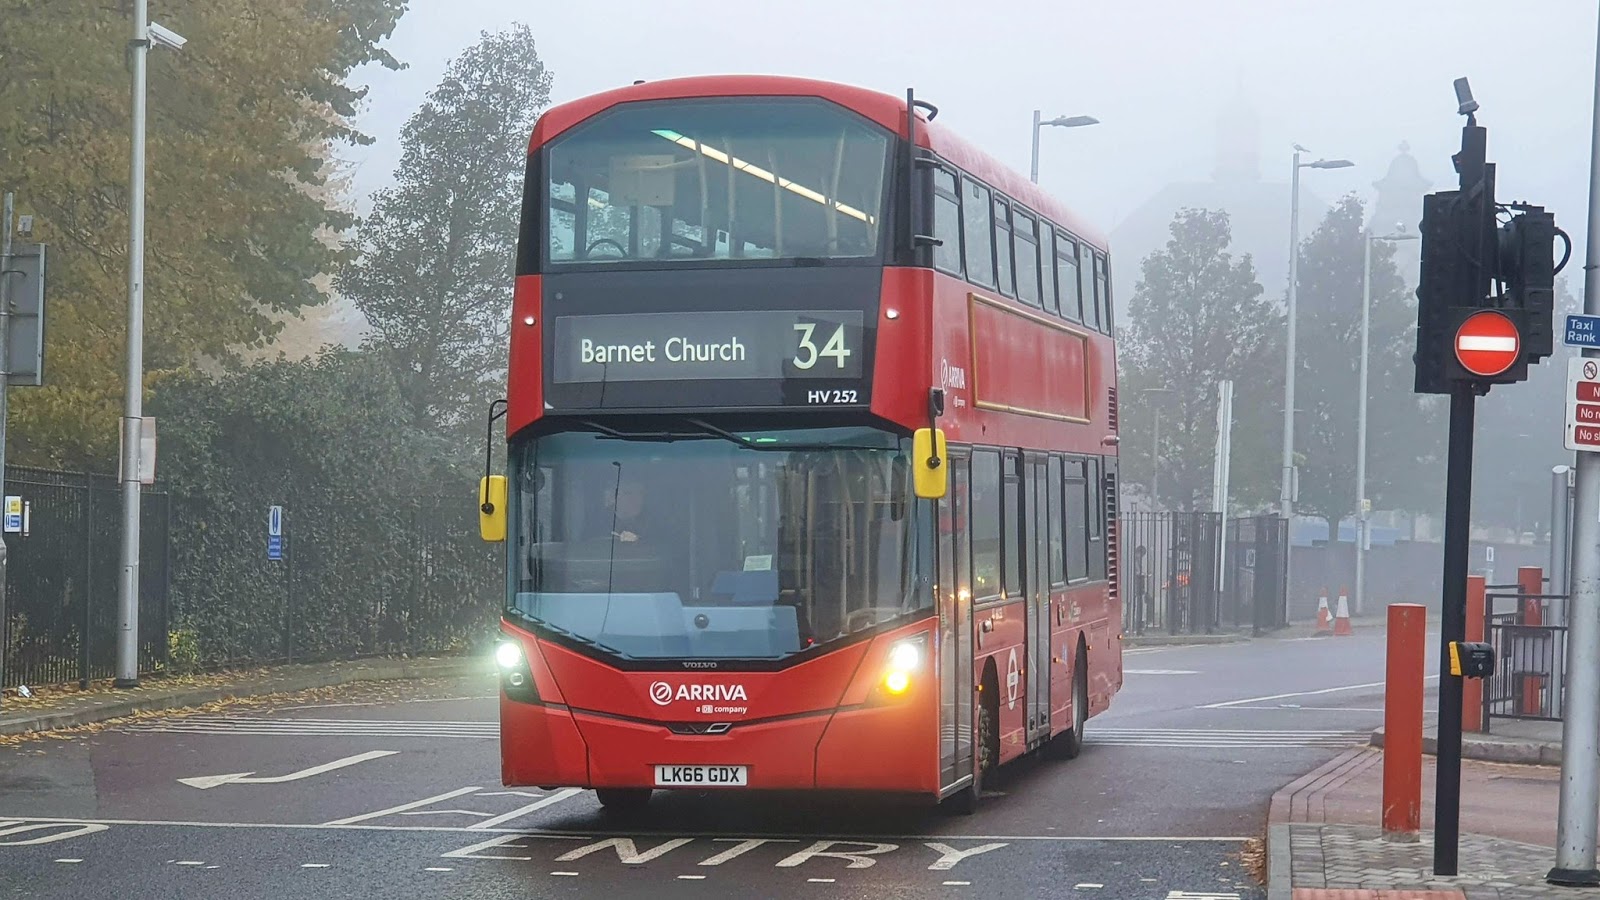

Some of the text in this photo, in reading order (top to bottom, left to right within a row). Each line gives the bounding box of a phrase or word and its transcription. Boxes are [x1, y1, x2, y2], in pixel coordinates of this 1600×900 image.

[1570, 319, 1594, 331] Taxi
[1567, 331, 1596, 343] Rank
[580, 336, 745, 363] Barnet Church
[792, 322, 851, 370] 34
[807, 390, 858, 403] HV 252
[1580, 408, 1594, 419] No
[1579, 429, 1592, 441] No
[682, 661, 718, 669] VOLVO
[675, 684, 748, 701] ARRIVA
[714, 706, 748, 715] company
[661, 767, 740, 783] LK66 GDX
[440, 834, 1010, 870] ENTRY
